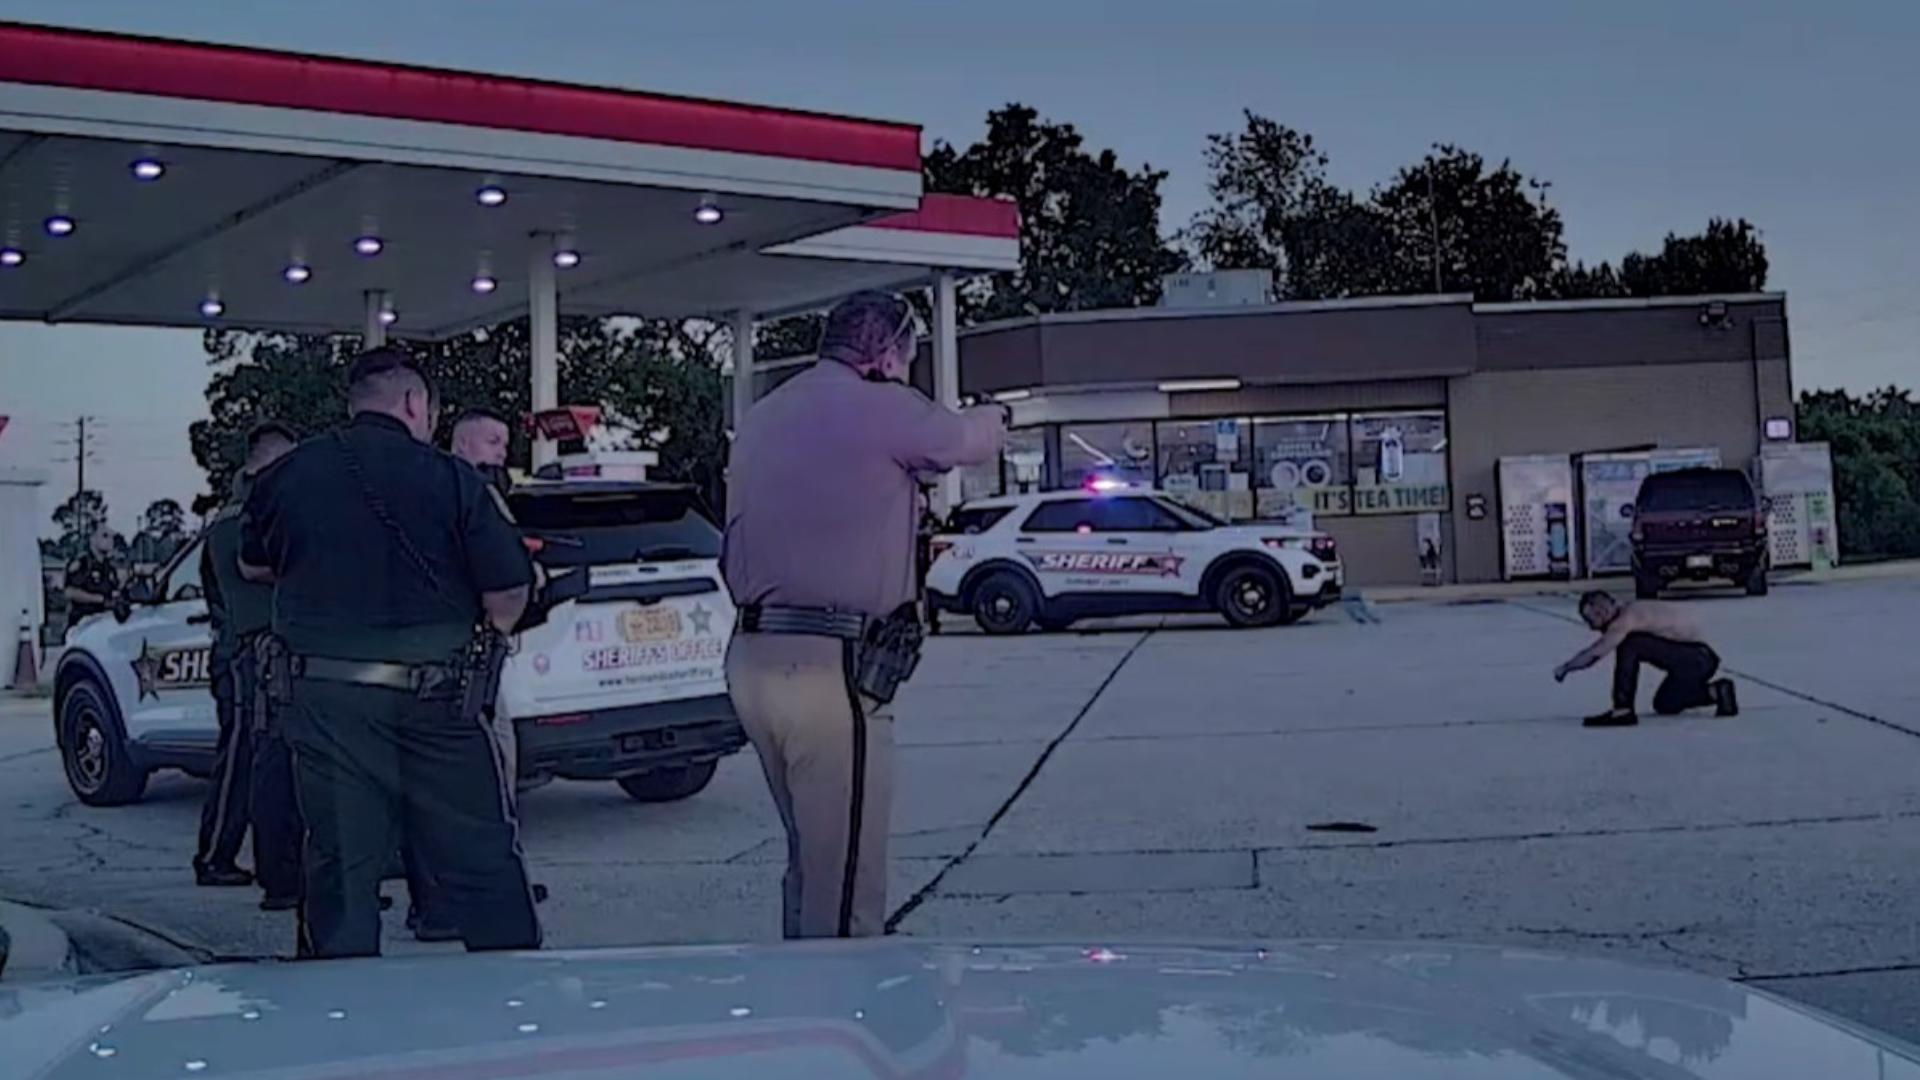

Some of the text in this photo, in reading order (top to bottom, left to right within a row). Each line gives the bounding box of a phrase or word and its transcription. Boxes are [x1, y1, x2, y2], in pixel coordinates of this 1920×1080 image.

[1314, 486, 1446, 511] IT'S TEA TIME!
[1039, 551, 1149, 571] SHERIFF
[582, 640, 723, 671] SHERIFF'S OFFICE
